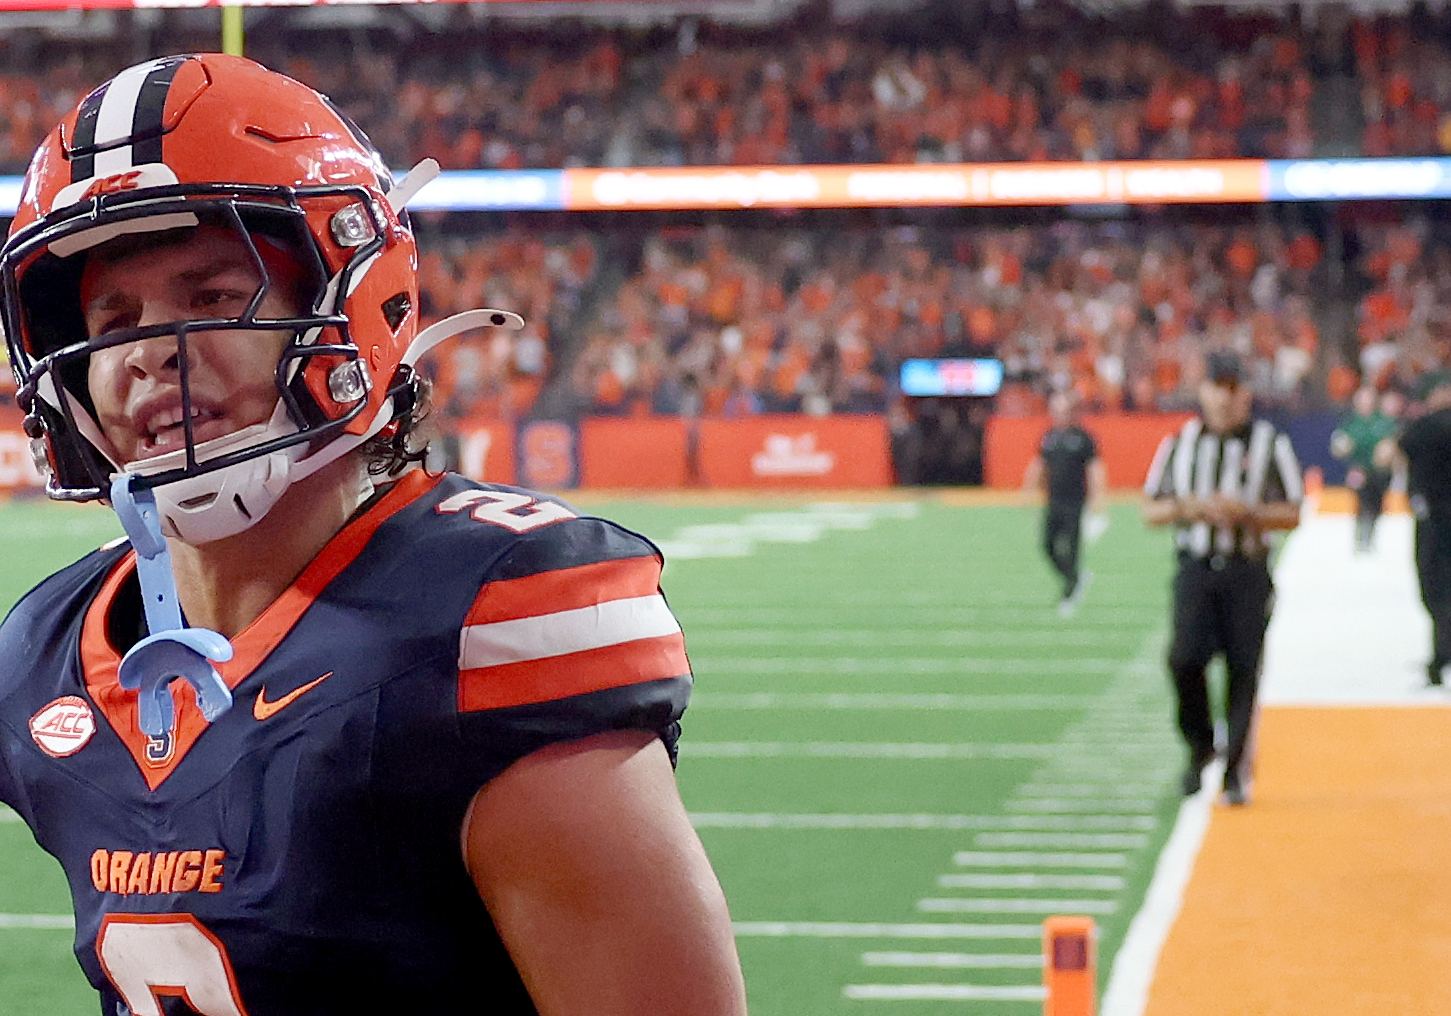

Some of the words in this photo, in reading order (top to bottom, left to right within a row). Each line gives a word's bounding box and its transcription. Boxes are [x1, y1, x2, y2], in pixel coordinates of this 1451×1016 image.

[79, 171, 143, 202] ACC
[434, 489, 578, 534] 2
[41, 712, 90, 733] ACC
[90, 848, 226, 895] ORANGE
